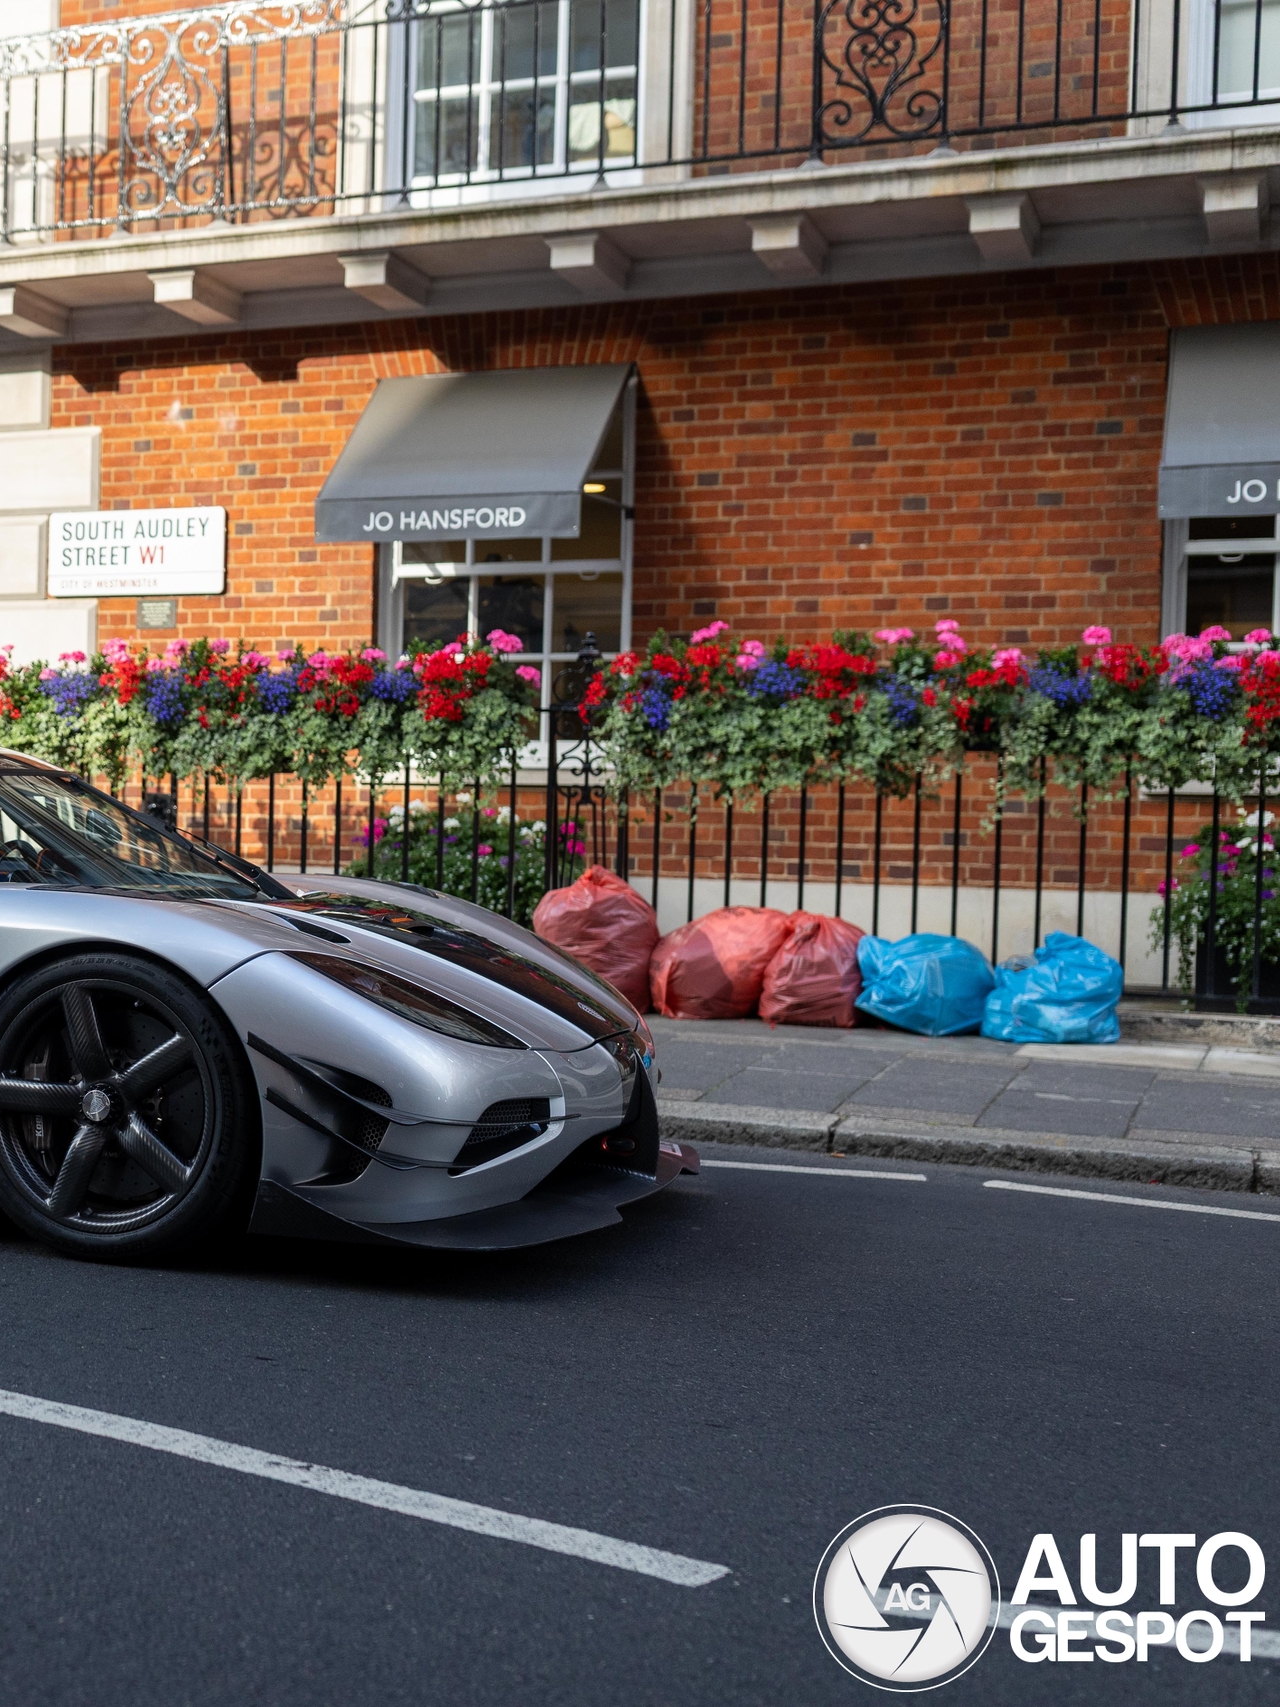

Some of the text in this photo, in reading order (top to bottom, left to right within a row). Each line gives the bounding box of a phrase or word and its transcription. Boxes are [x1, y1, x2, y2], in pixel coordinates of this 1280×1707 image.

[1226, 479, 1267, 503] JO
[62, 517, 210, 541] SOUTH AUDLEY
[362, 507, 526, 532] JO HANSFORD
[62, 545, 165, 567] STREET W1
